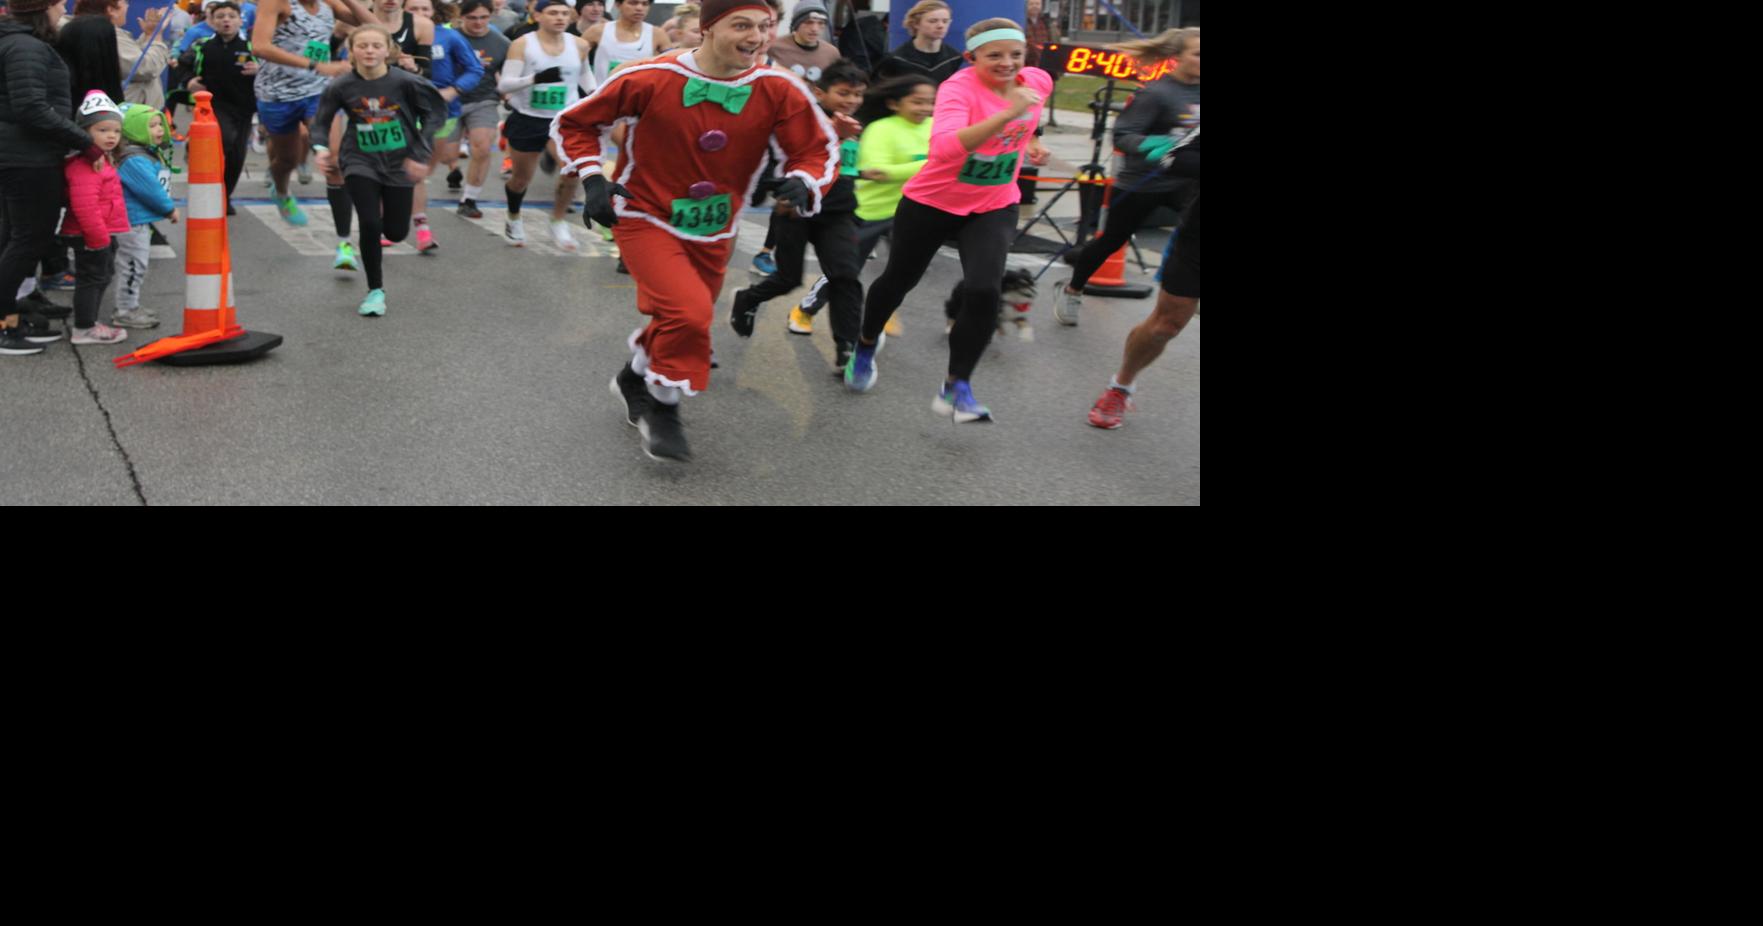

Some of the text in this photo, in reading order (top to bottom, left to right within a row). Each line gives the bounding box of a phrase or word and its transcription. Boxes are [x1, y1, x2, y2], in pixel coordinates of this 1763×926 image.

[359, 126, 402, 146] 1075
[962, 158, 1017, 179] 1214
[672, 203, 727, 228] 1348
